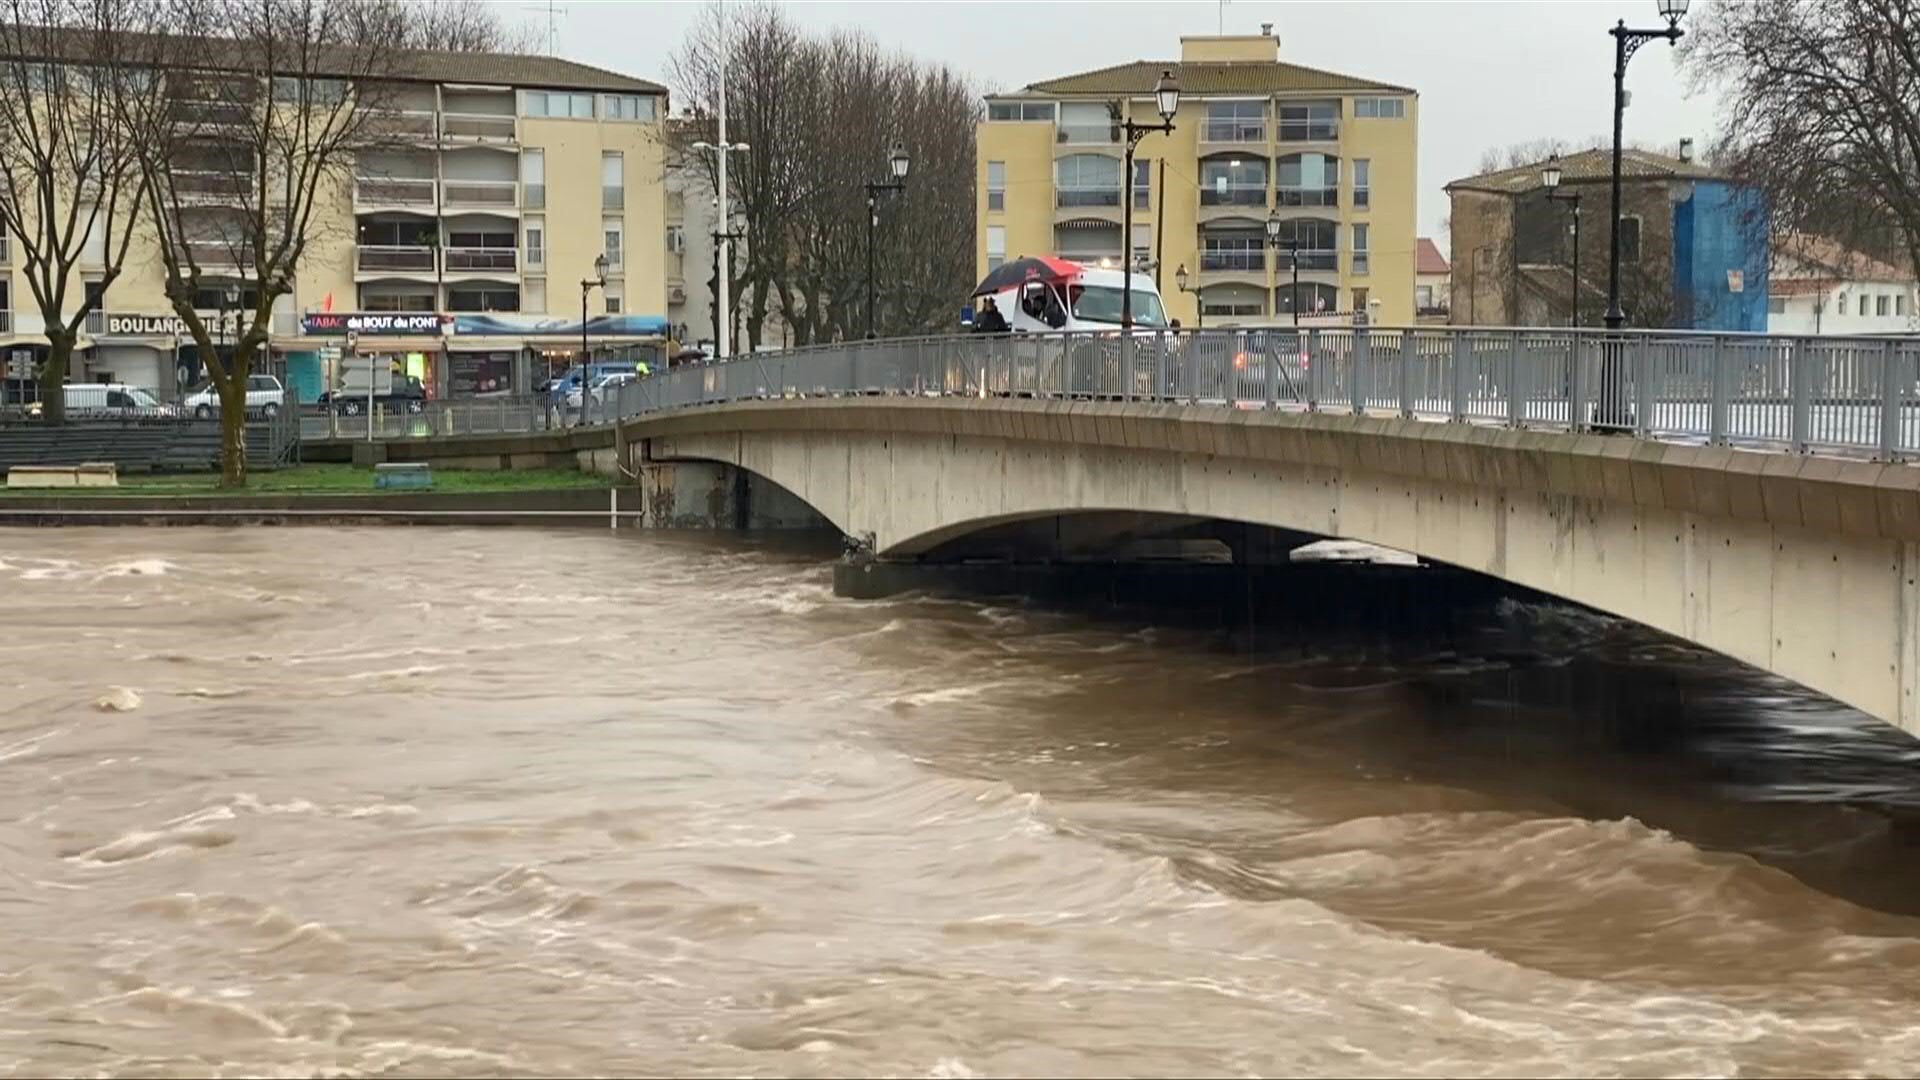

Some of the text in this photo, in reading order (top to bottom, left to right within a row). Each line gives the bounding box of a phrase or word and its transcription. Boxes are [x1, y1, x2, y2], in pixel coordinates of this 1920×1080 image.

[347, 316, 362, 329] du
[363, 316, 393, 329] BOUT
[394, 316, 408, 329] du
[409, 316, 438, 329] PONT
